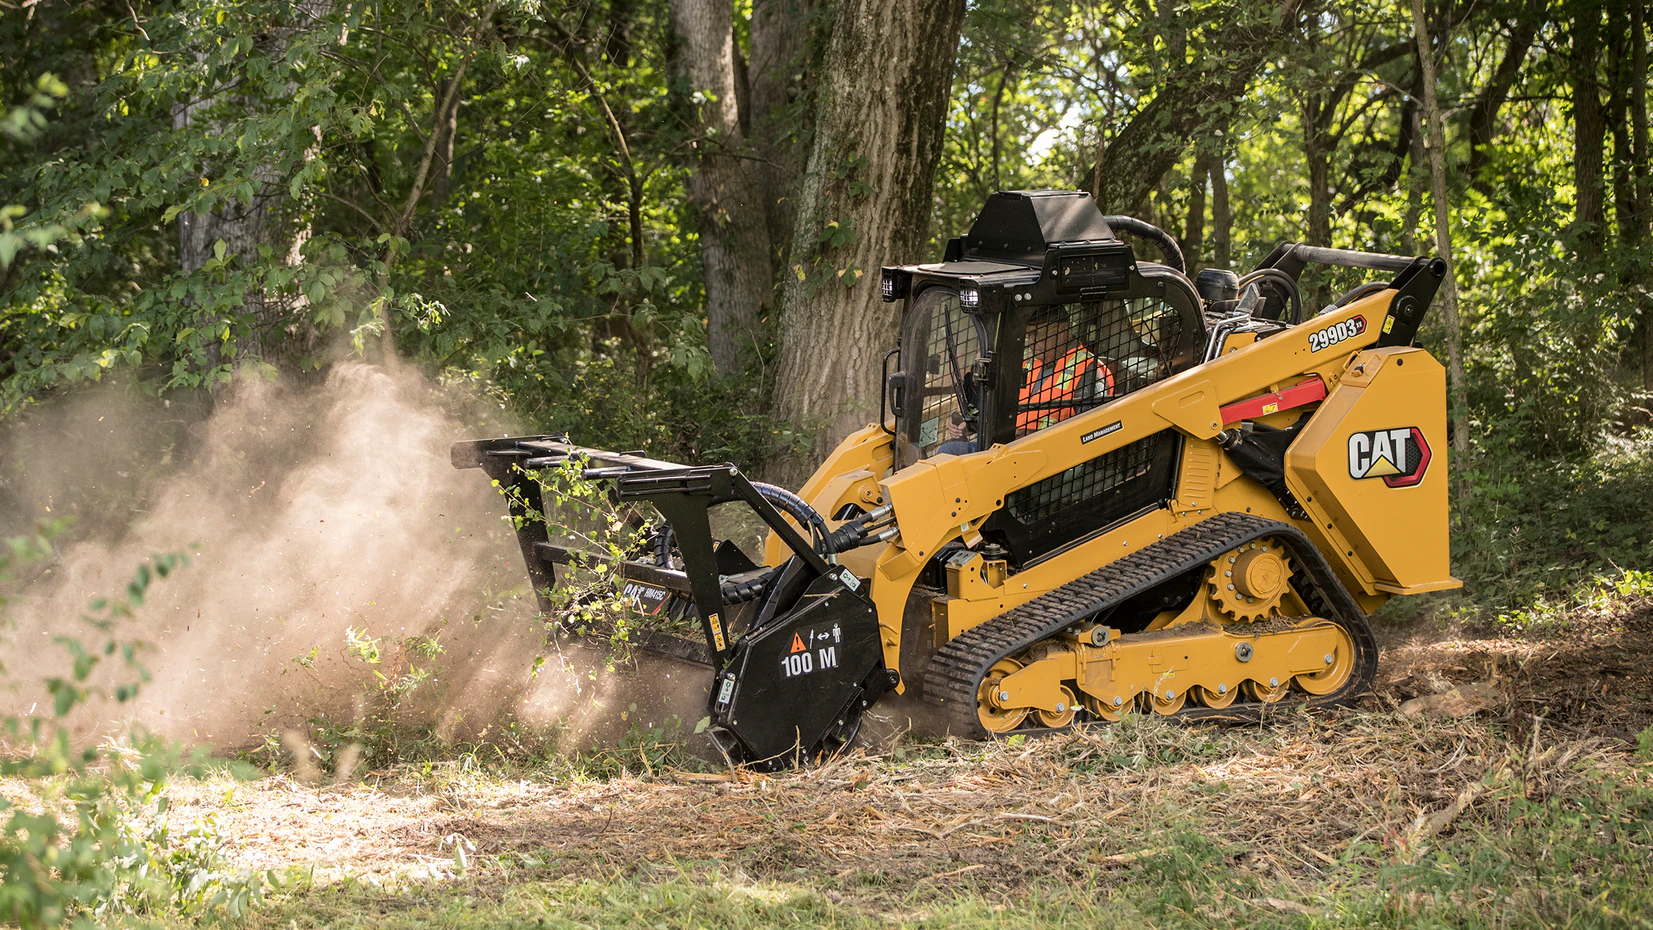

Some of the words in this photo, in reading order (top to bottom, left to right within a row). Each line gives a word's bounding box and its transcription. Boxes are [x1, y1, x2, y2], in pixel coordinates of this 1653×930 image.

[1309, 318, 1357, 353] 299D3
[1348, 428, 1411, 479] CAT
[781, 652, 813, 677] 100
[818, 646, 838, 670] M
